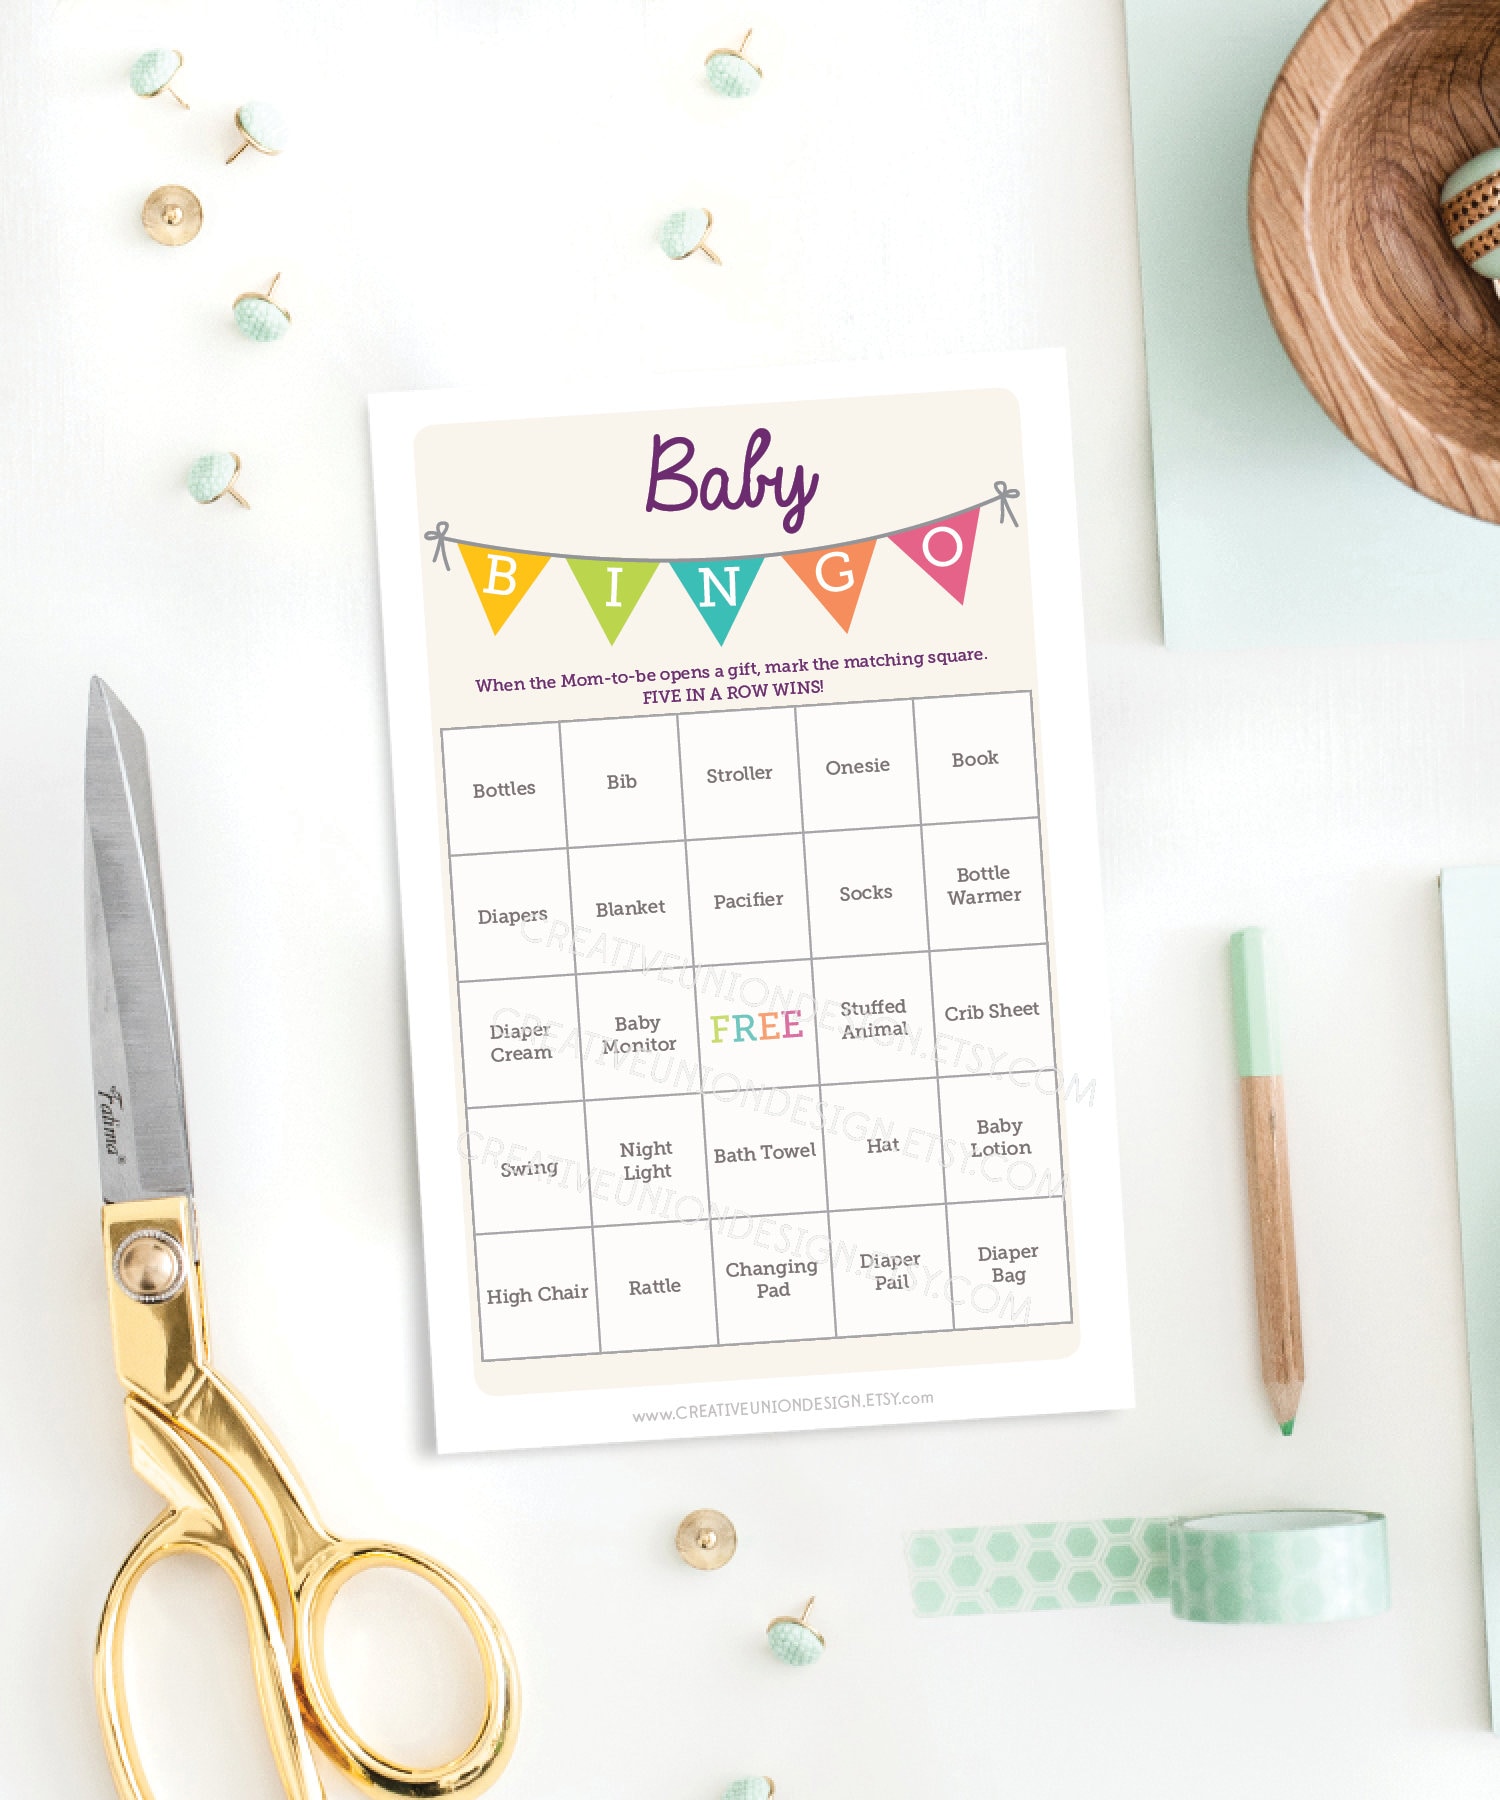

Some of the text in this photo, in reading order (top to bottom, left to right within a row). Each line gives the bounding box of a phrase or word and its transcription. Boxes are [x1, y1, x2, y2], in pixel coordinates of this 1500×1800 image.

[646, 428, 819, 534] Baby
[475, 651, 988, 692] When the Mom-to-be opens a gift, mark the matching square.
[643, 680, 824, 704] FIVE IN A ROW WINS!
[826, 757, 890, 776] Onesie
[952, 749, 1000, 767] Book
[607, 773, 637, 790] Bib
[706, 765, 773, 784] Stroller
[473, 780, 536, 798] Bottles
[957, 864, 1010, 882] Bottle
[714, 891, 784, 909] Pacifier
[840, 884, 893, 902] Socks
[947, 890, 1022, 906] Warmer
[478, 908, 548, 926] Diapers
[596, 899, 666, 917] Blanket
[841, 998, 907, 1017] Stuffed
[945, 1002, 1040, 1021] Crib Sheet
[489, 1023, 551, 1041] Diaper
[615, 1014, 661, 1033] Baby
[710, 1009, 804, 1043] FREE
[842, 1020, 909, 1040] Animal
[491, 1047, 553, 1063] Cream
[602, 1037, 677, 1055] Monitor
[977, 1117, 1024, 1137] Baby
[620, 1140, 673, 1161] Night
[714, 1142, 817, 1163] Bath Towel
[867, 1137, 900, 1154] Hat
[970, 1140, 1032, 1158] Lotion
[500, 1160, 559, 1178] Swing
[624, 1163, 672, 1184] Light
[860, 1253, 922, 1271] Diaper
[978, 1246, 1039, 1264] Diaper
[726, 1258, 818, 1279] Changing
[992, 1268, 1027, 1285] Bag
[629, 1277, 681, 1296] Rattle
[757, 1282, 791, 1299] Pad
[875, 1273, 911, 1291] Pail
[487, 1284, 589, 1308] High Chair
[632, 1391, 935, 1423] www.CREATIVEUNIONDESIGN.ETSY.com
